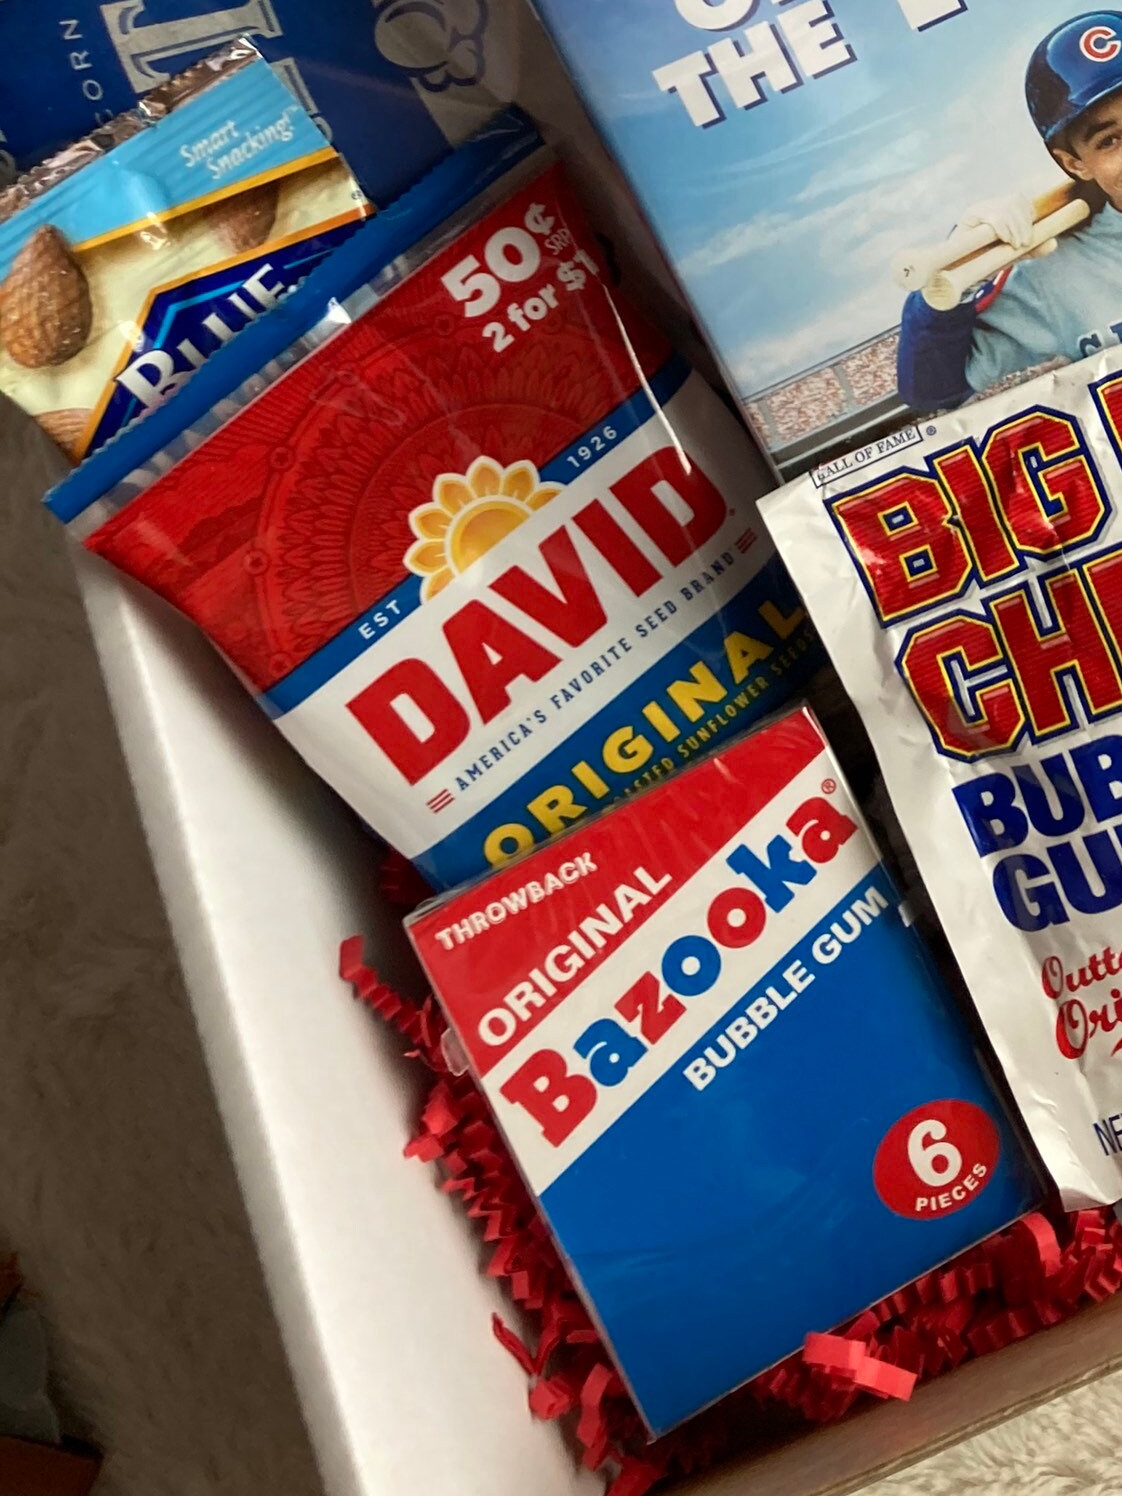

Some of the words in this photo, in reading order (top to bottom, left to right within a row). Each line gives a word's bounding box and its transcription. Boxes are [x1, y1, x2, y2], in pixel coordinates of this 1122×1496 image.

[179, 118, 239, 168] Smart
[440, 202, 557, 319] 50¢
[481, 320, 515, 353] 2
[507, 281, 560, 330] for
[824, 405, 1113, 627] BIG
[853, 446, 875, 466] OF
[875, 426, 917, 456] FAME
[357, 598, 401, 641] EST
[565, 424, 619, 469] 1926
[344, 444, 728, 788] DAVID
[453, 706, 548, 792] AMERICA'S
[550, 635, 633, 712] FAVORITE
[634, 599, 678, 638] SEED
[680, 549, 735, 601] BRAND
[482, 599, 808, 869] ORIGINAL
[676, 674, 770, 757] SUNFLOWER
[434, 851, 599, 952] THROWBACK
[476, 863, 673, 1048] ORIGINAL
[499, 795, 859, 1149] Bazooka
[681, 958, 816, 1092] BUBBLE
[811, 885, 889, 966] GUM
[907, 1118, 963, 1188] 6
[914, 1160, 989, 1213] PIECES
